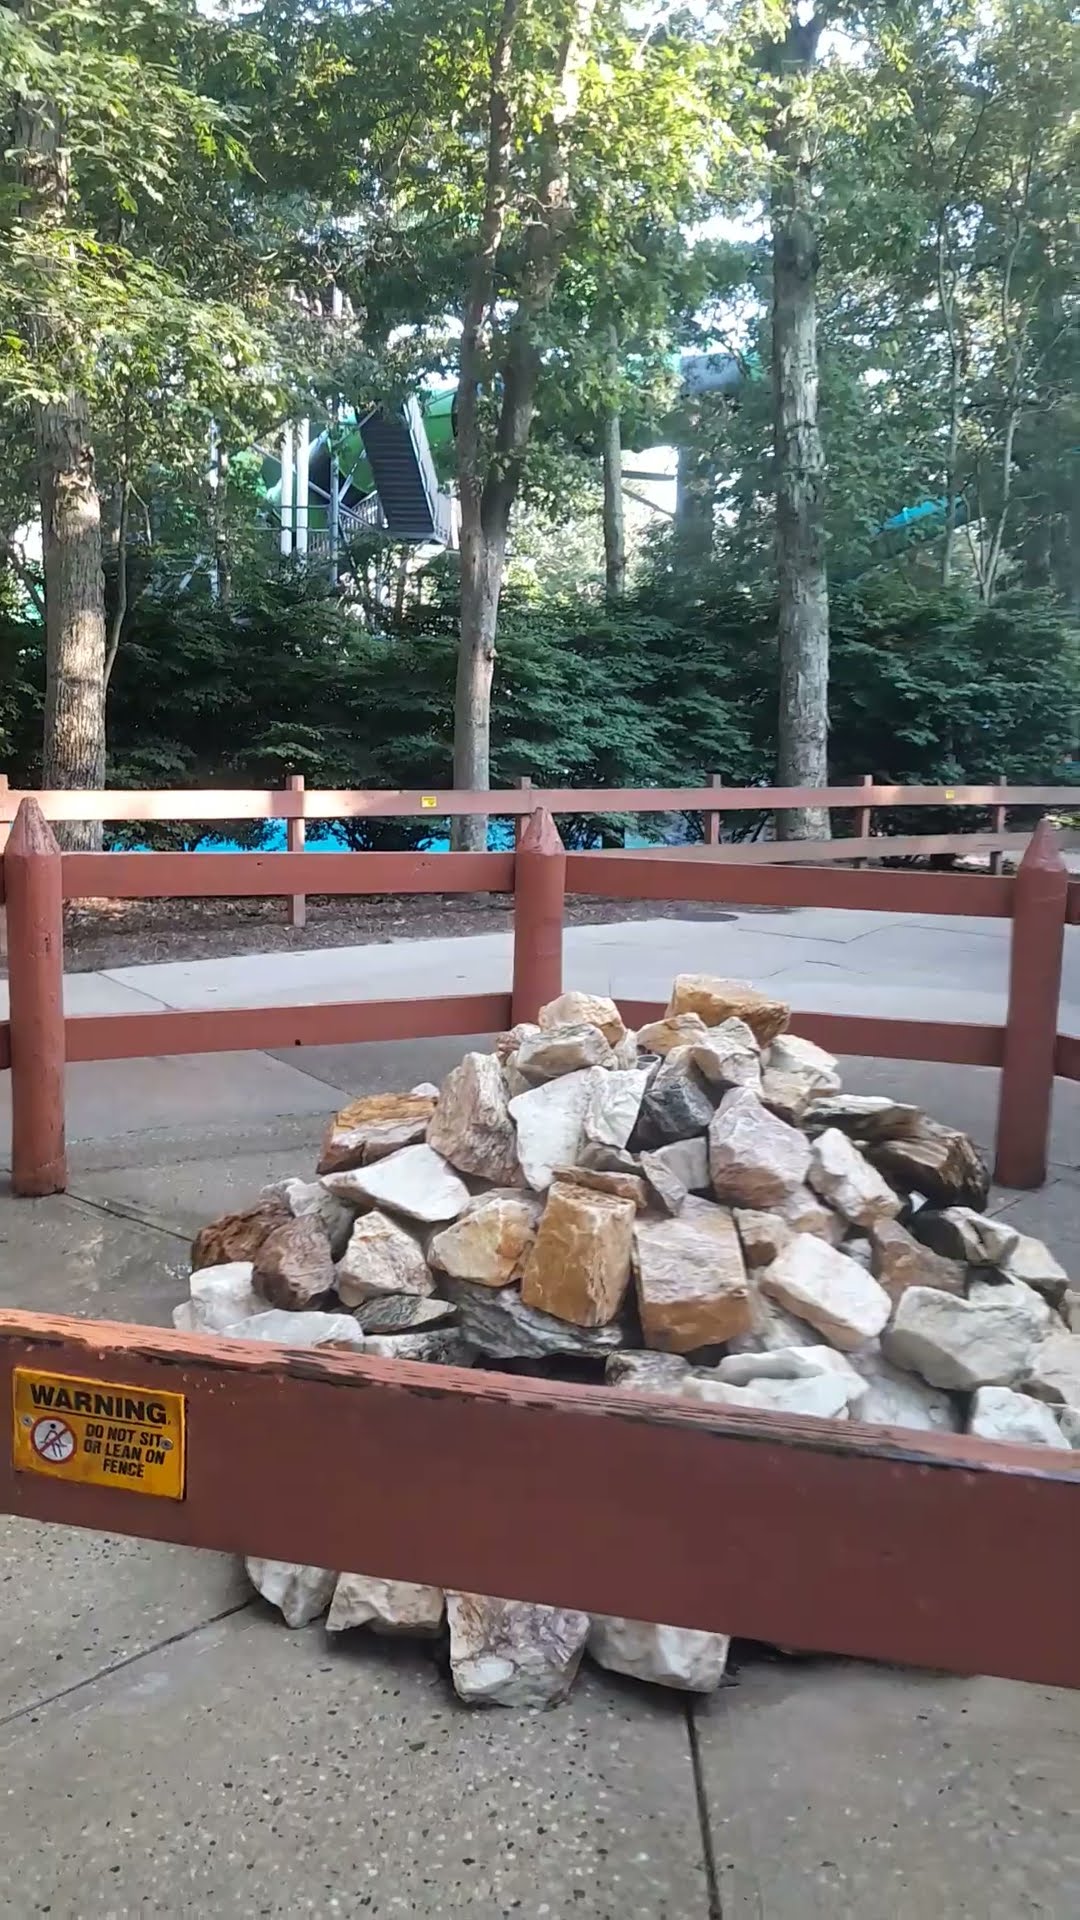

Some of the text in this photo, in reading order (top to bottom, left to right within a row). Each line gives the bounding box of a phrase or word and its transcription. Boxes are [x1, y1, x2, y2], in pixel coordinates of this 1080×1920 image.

[30, 1383, 168, 1425] WARNING
[86, 1423, 163, 1448] DO NOT SIT
[84, 1438, 166, 1465] OR LEAN ON
[103, 1458, 145, 1478] FENCE
